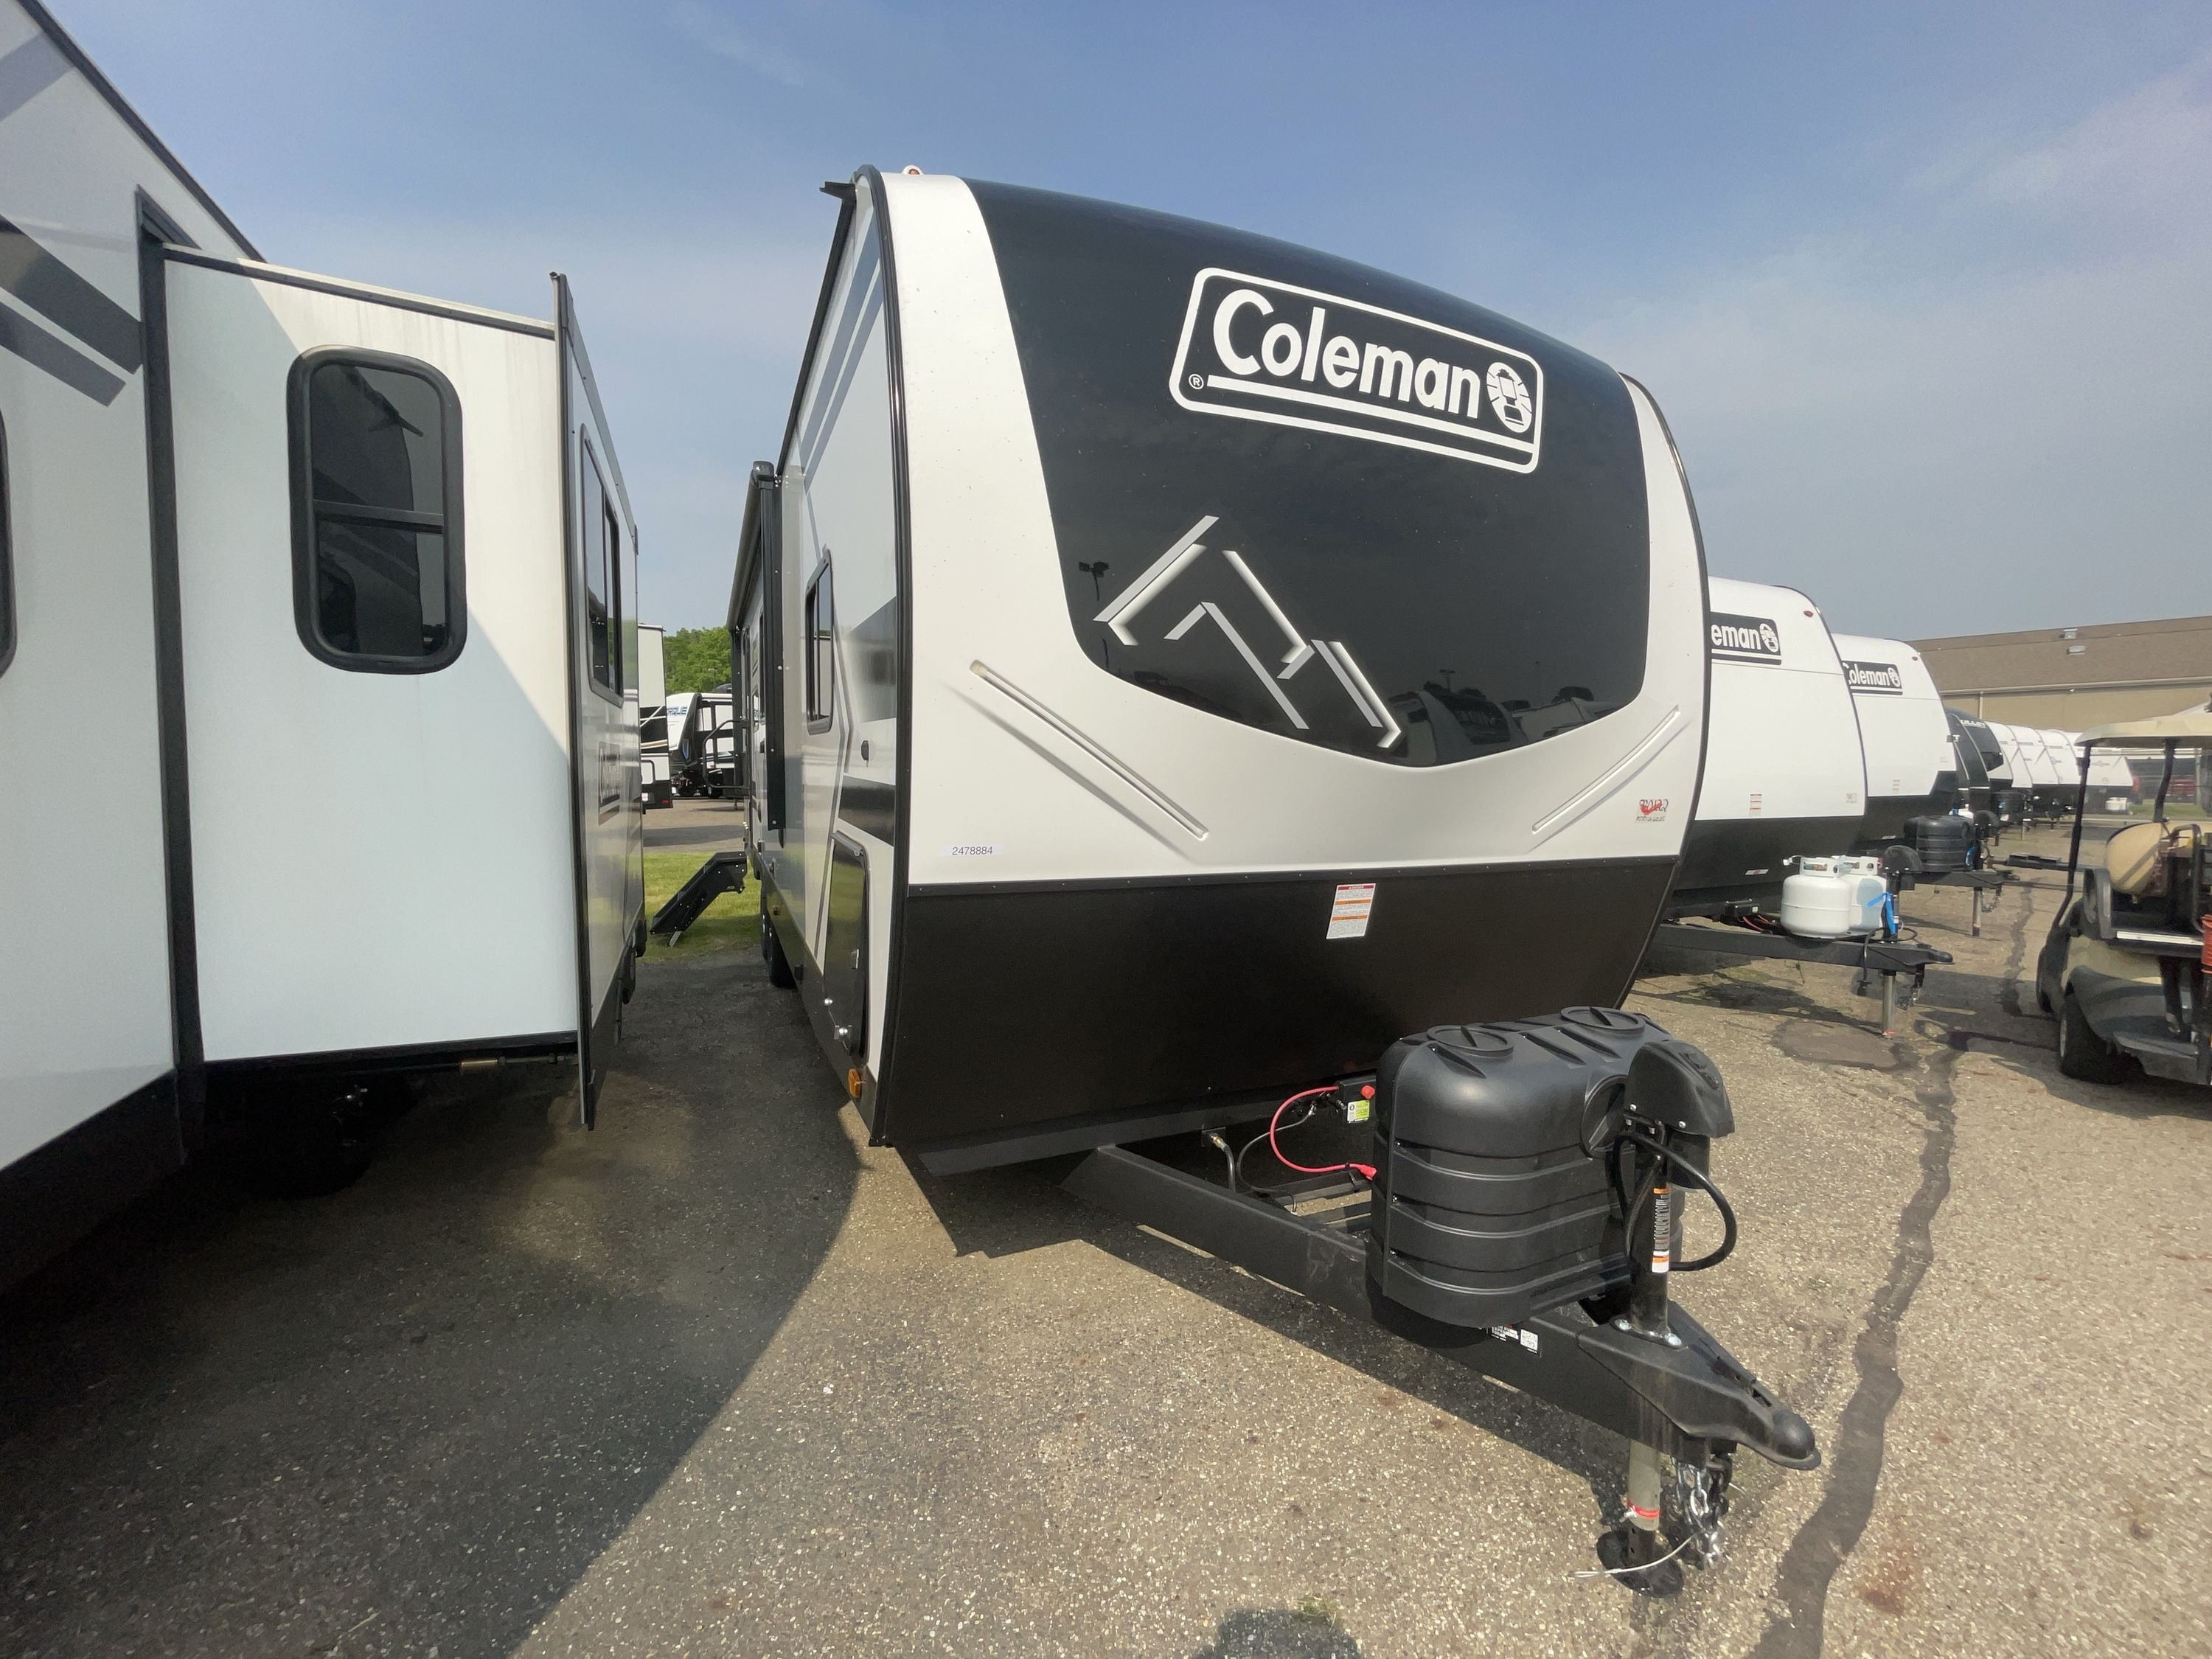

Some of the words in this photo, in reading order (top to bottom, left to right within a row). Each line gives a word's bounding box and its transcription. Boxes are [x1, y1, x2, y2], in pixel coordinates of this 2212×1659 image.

[1213, 288, 1481, 420] Coleman
[1711, 624, 1761, 650] eman
[951, 846, 993, 856] 2478884
